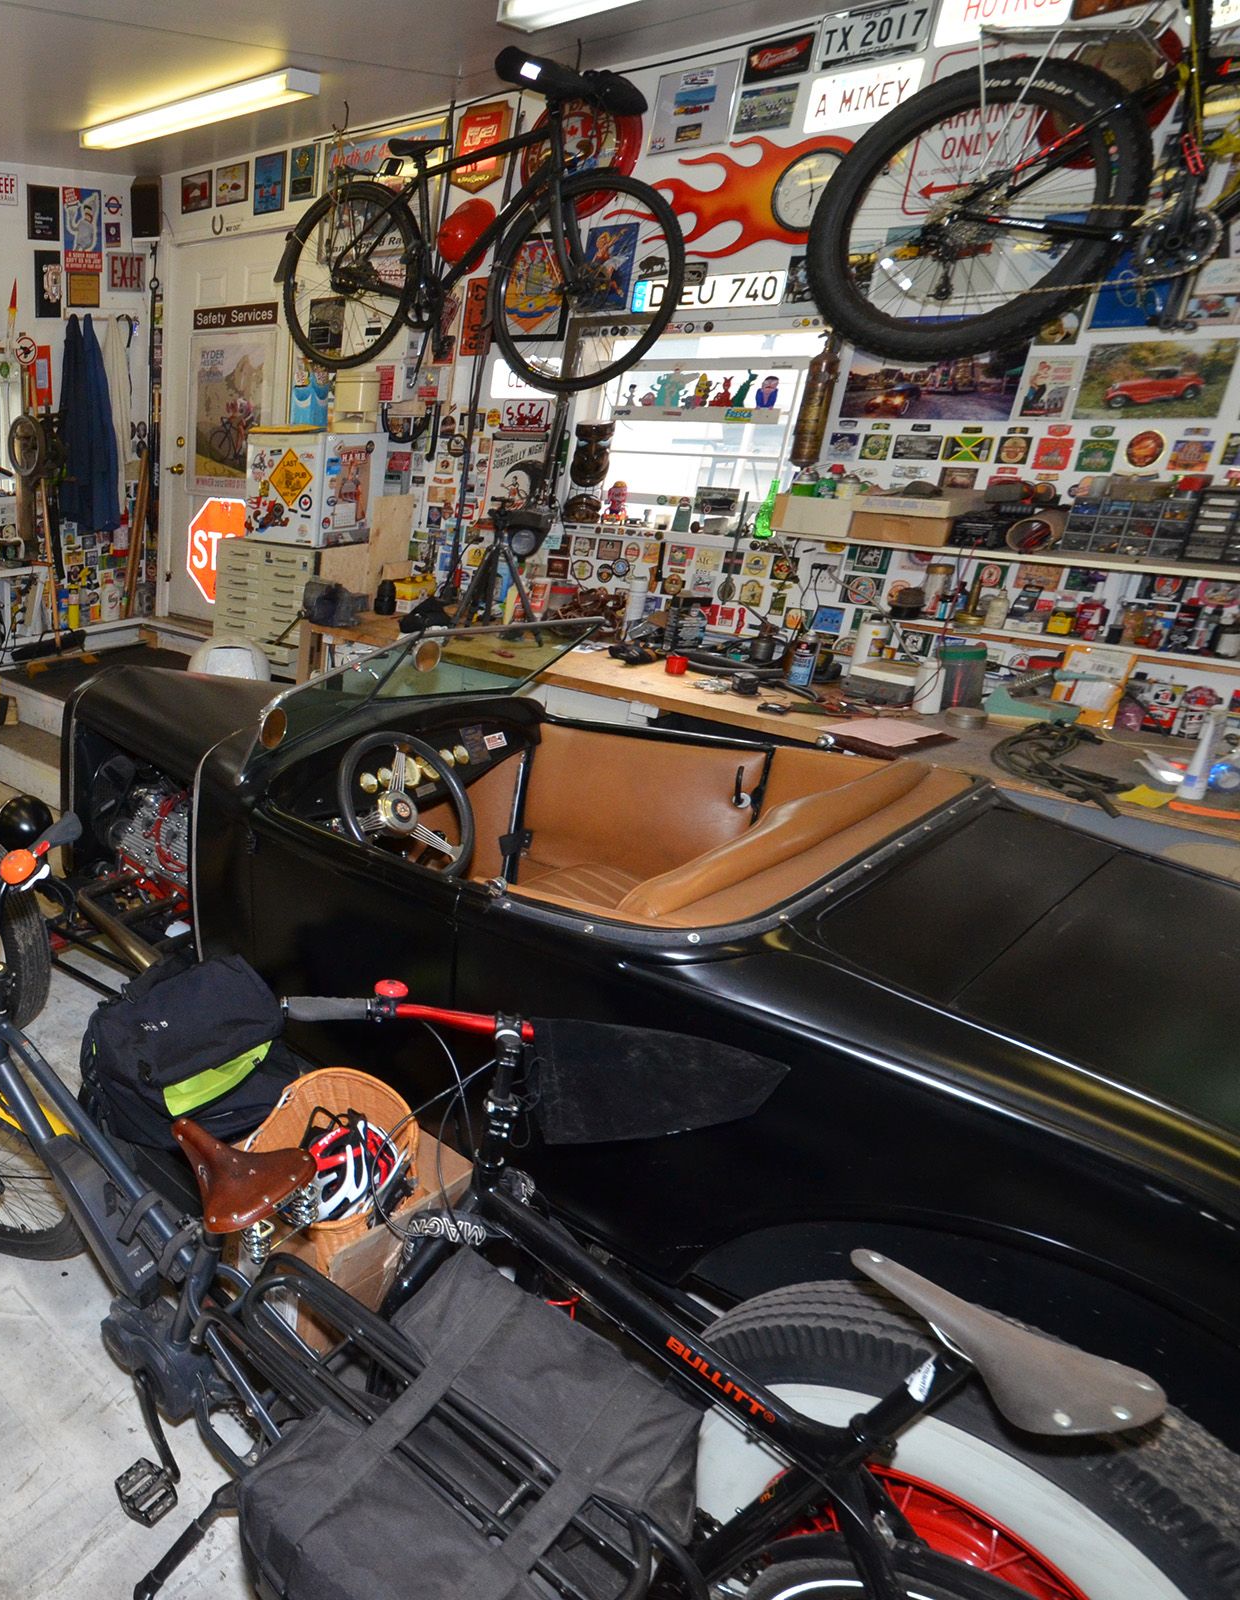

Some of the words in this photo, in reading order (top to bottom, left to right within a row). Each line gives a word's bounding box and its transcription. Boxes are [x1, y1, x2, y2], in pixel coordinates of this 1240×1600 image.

[825, 25, 855, 55] TX
[859, 8, 929, 48] 2017
[814, 93, 827, 118] A
[838, 77, 911, 114] MIKEY
[331, 147, 360, 168] North
[363, 144, 377, 163] of
[941, 132, 1000, 160] ONLY
[112, 255, 144, 289] EXIT
[728, 275, 778, 304] 740
[196, 312, 227, 326] Safety
[231, 308, 274, 323] Services
[201, 349, 225, 360] RYDER
[282, 459, 298, 468] LAST
[294, 471, 308, 480] PUB
[191, 529, 237, 571] ST
